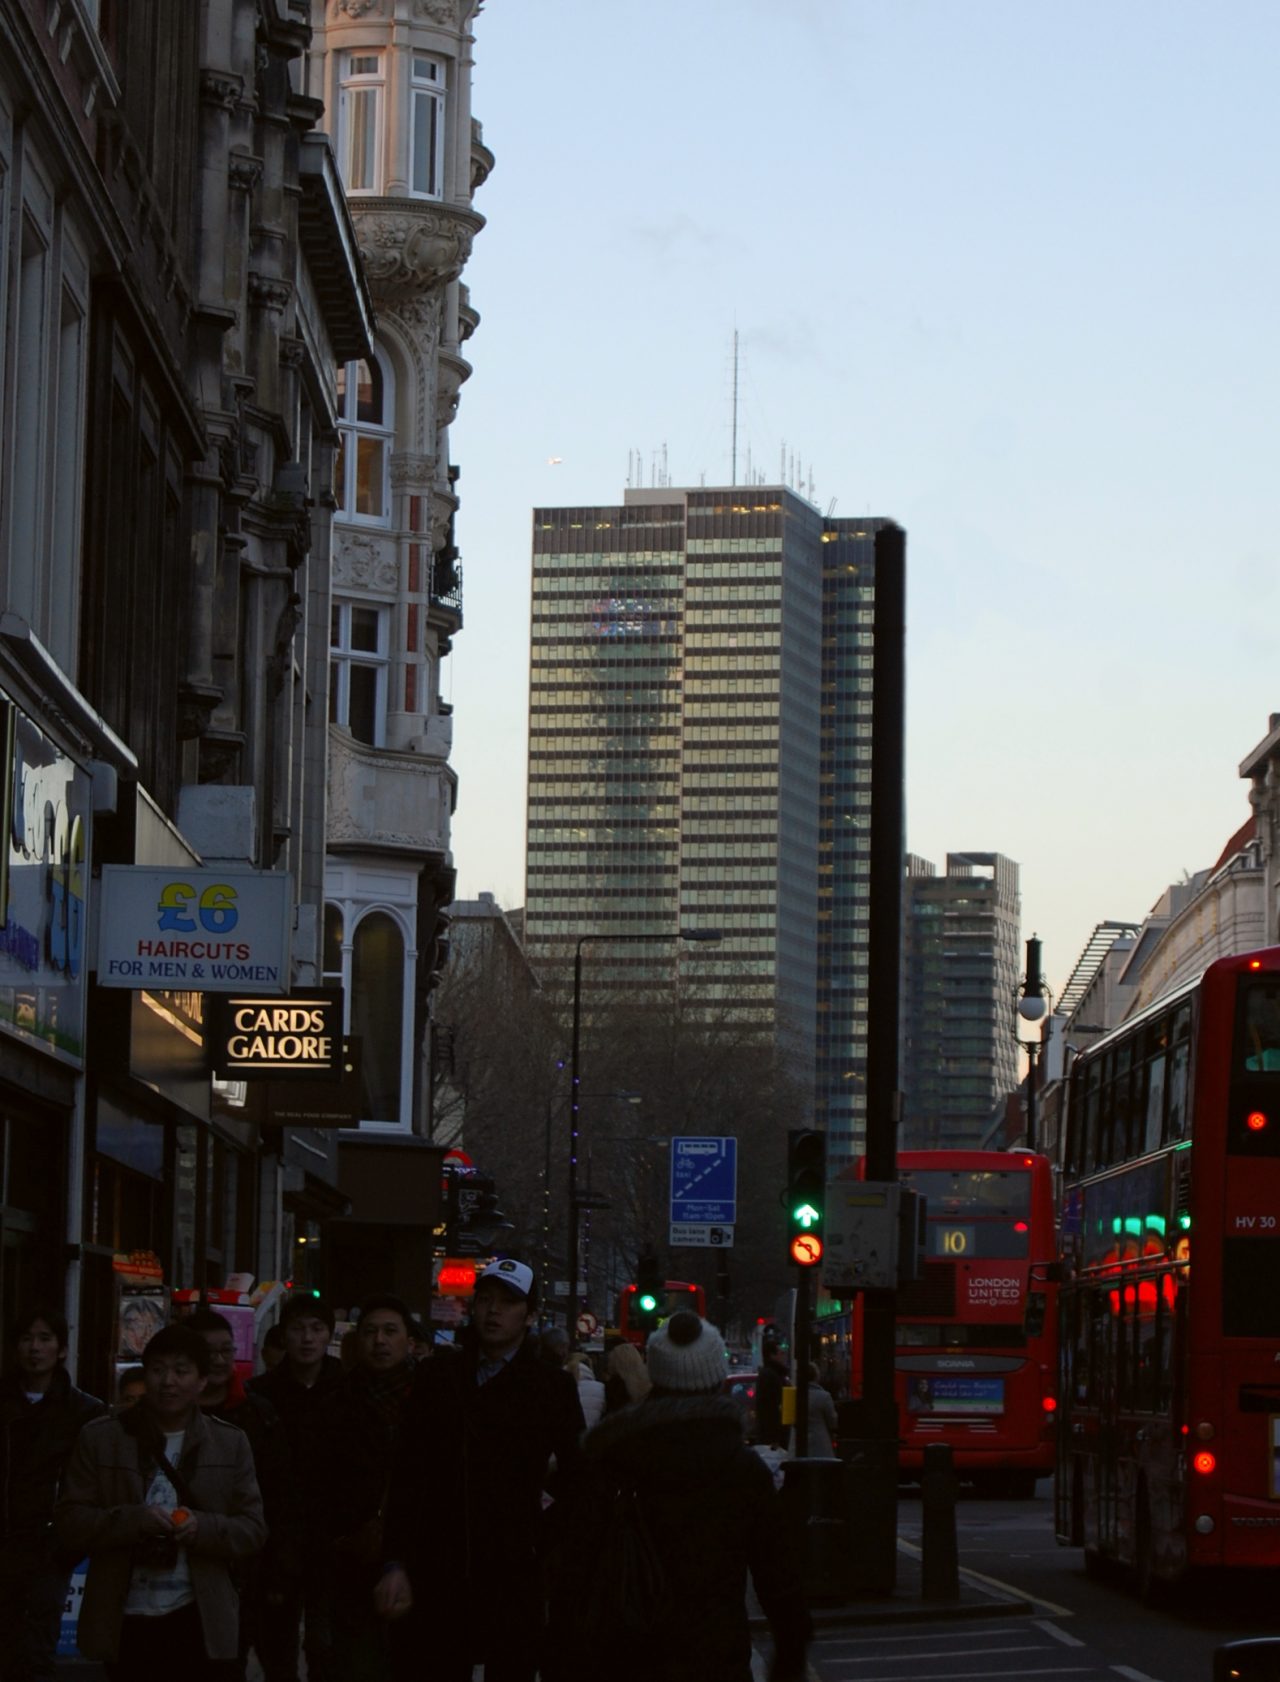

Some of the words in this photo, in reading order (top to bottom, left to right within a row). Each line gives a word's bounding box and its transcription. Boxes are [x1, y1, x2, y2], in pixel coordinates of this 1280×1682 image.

[157, 882, 239, 934] £6
[138, 940, 250, 960] HAIRCUTS
[109, 960, 143, 976] FOR
[149, 961, 187, 978] MEN
[192, 963, 205, 978] &
[212, 964, 278, 981] WOMEN
[235, 1008, 324, 1033] CARDS
[227, 1035, 332, 1059] GALORE
[1235, 1216, 1256, 1229] HV
[1259, 1216, 1277, 1229] 30
[944, 1230, 967, 1253] 10
[968, 1278, 1020, 1288] LONDON
[968, 1288, 1020, 1298] UNITED
